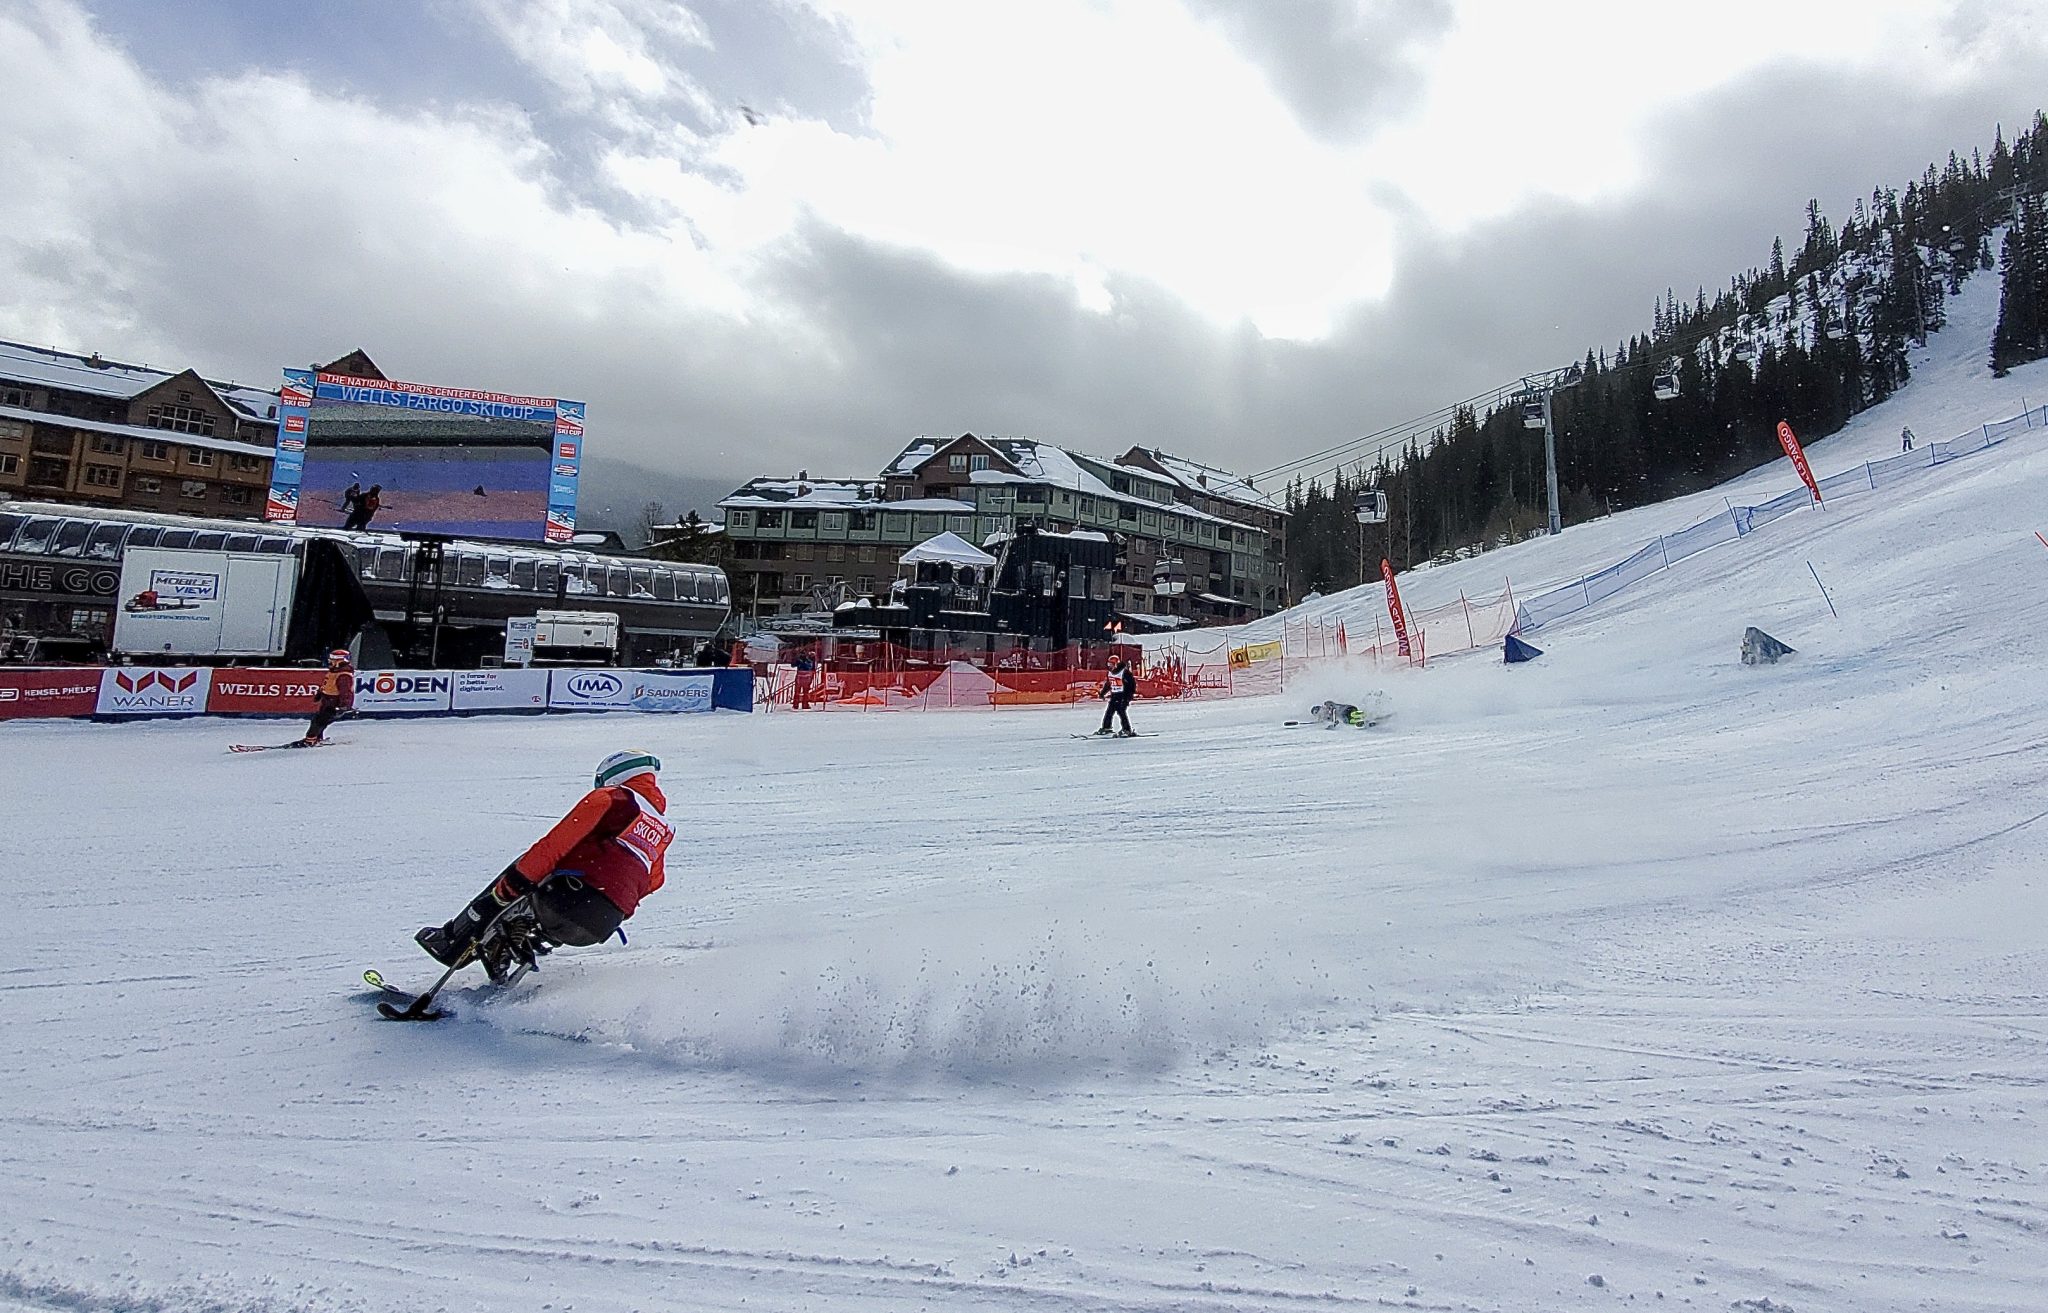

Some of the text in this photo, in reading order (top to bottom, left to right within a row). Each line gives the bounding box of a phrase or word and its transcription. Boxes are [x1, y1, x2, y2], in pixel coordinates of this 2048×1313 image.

[326, 375, 552, 407] THE NATIONAL SPORTS CENTER FOR THE DISABLED
[341, 386, 535, 419] WELLS FARGO SKI CUP
[1781, 427, 1802, 462] FARGO
[0, 563, 121, 595] HE GO
[155, 577, 213, 587] MOBILE
[175, 586, 213, 594] VIEW
[1393, 607, 1409, 653] WELLS
[24, 688, 60, 697] HENSEL
[62, 685, 97, 695] PHELPS
[217, 683, 320, 696] WELLS FAR
[577, 679, 614, 691] IMA
[646, 688, 709, 698] SAUNDERS
[113, 695, 195, 707] WANER
[633, 821, 647, 840] SKI
[646, 829, 662, 847] CUP
